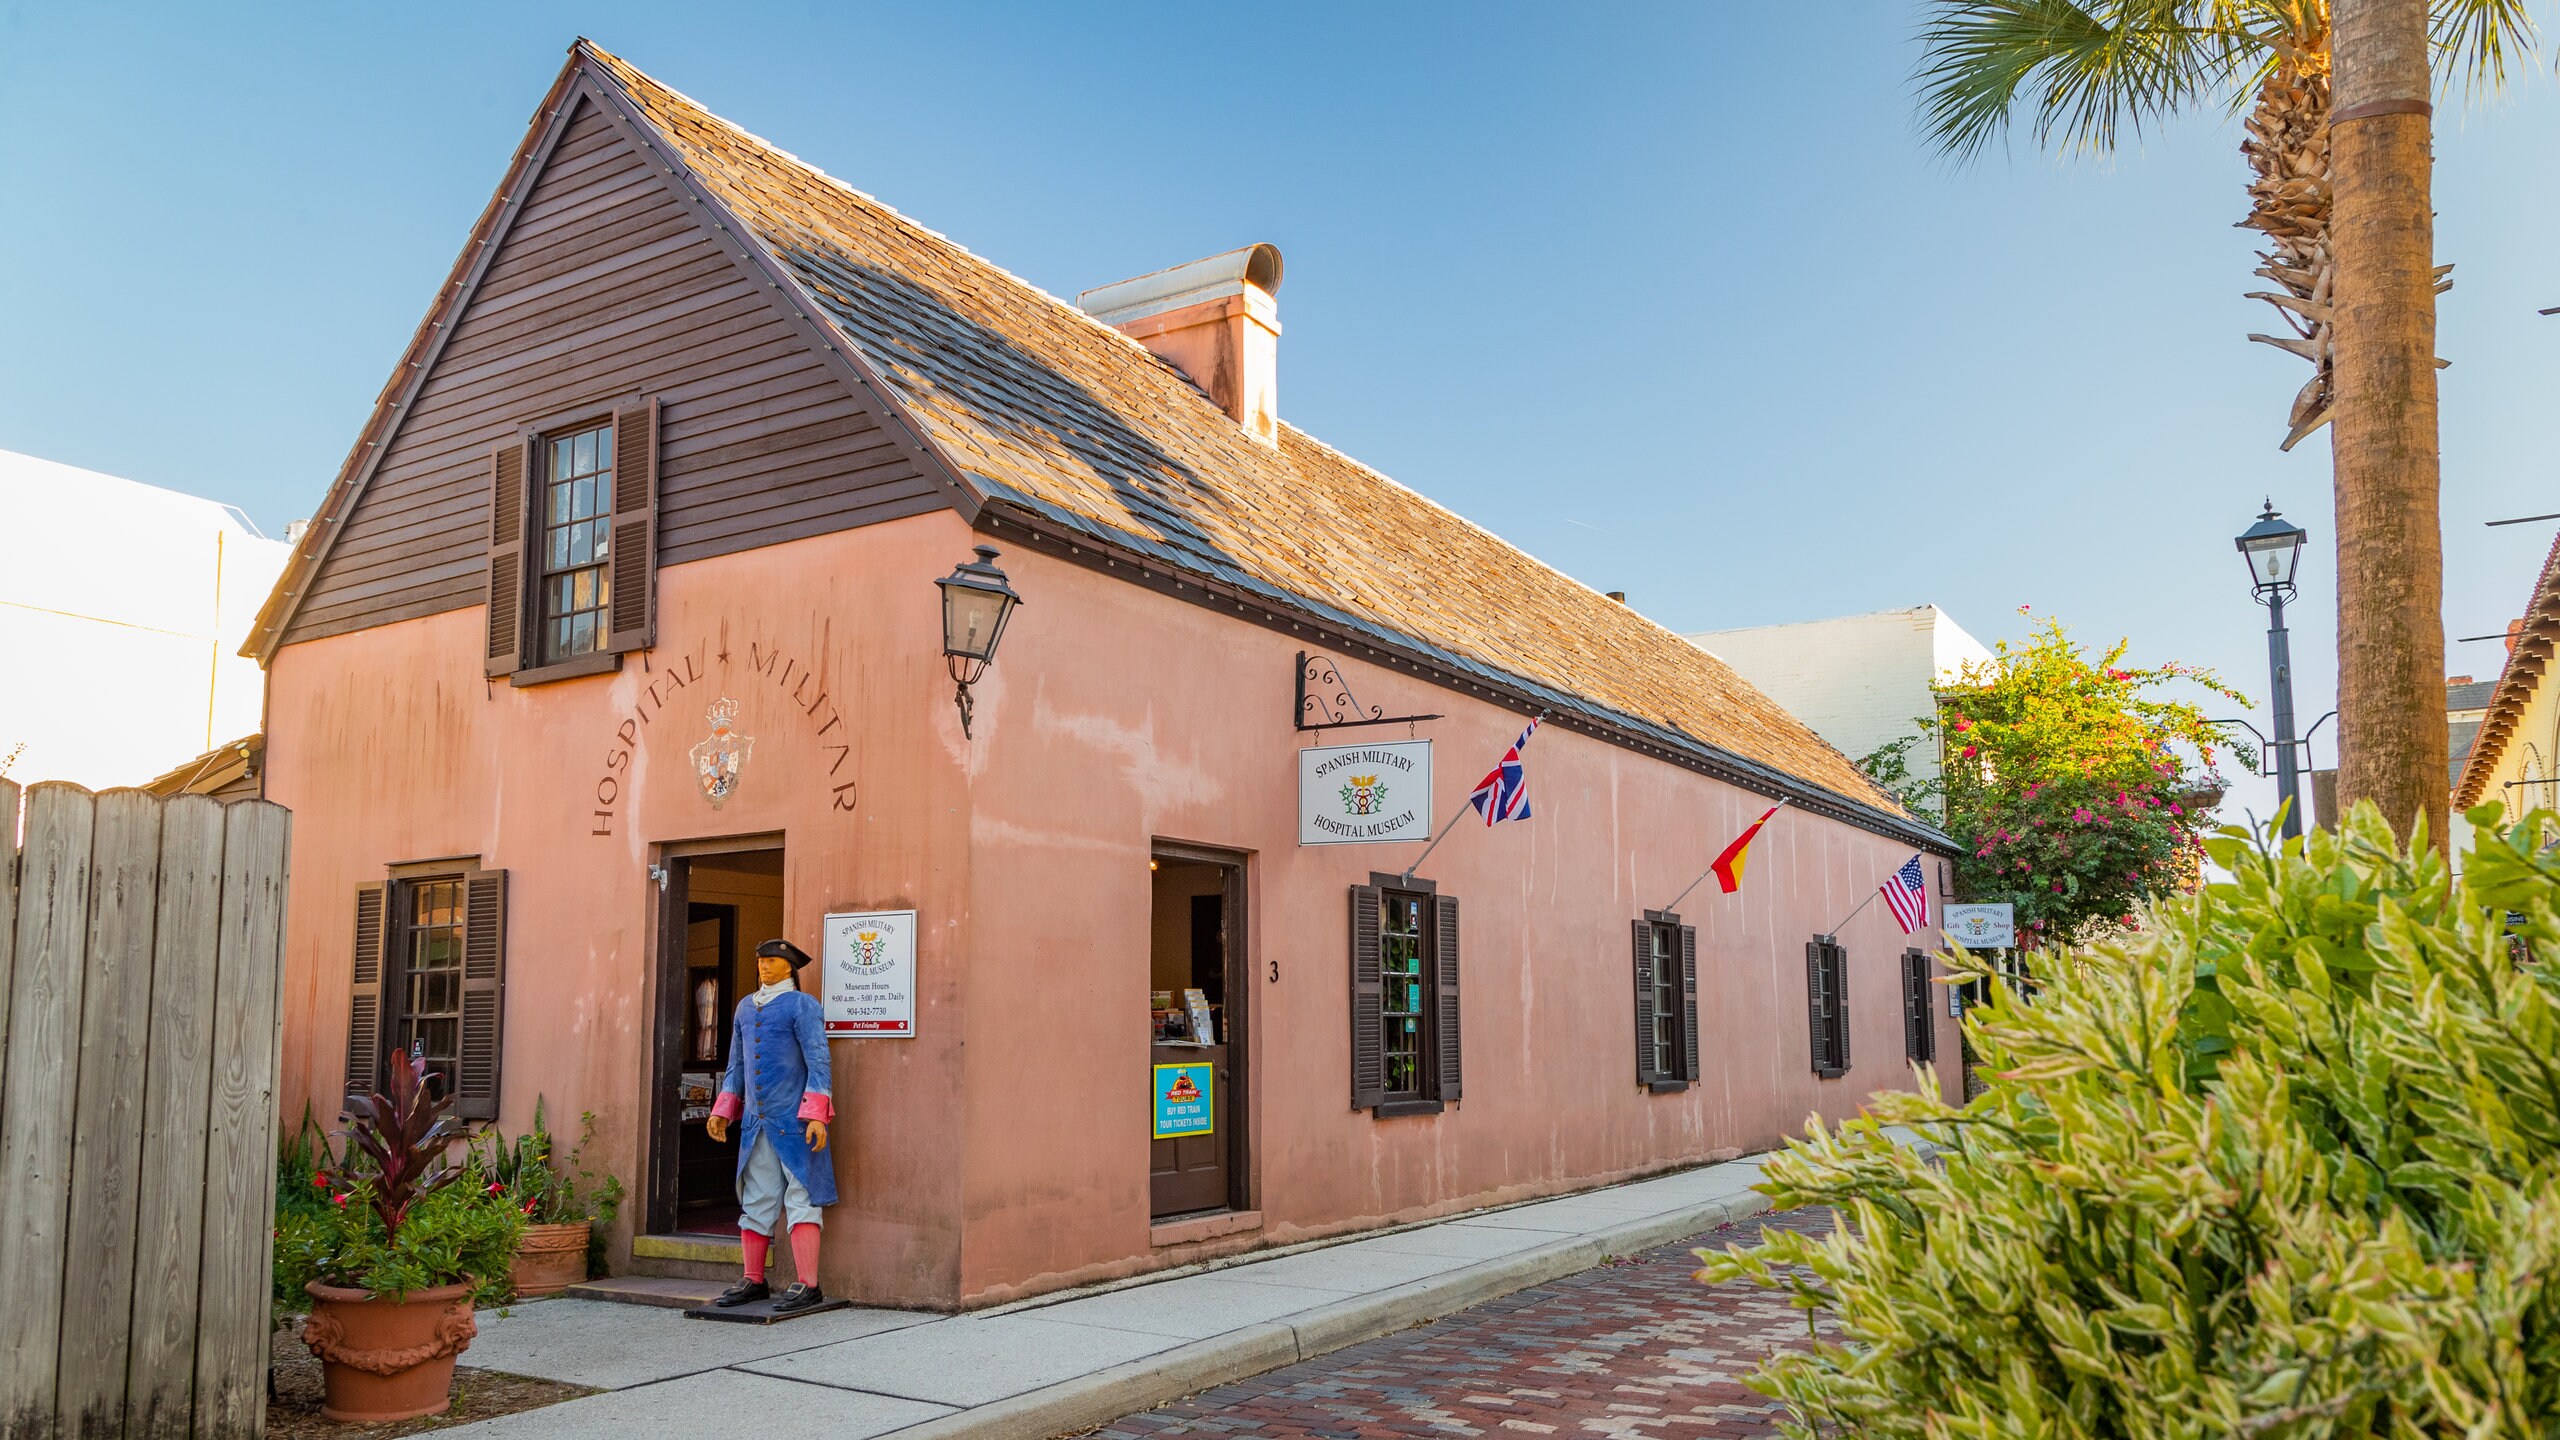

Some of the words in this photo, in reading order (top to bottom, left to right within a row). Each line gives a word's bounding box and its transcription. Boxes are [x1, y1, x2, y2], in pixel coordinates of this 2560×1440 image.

[592, 654, 704, 837] HOSPITAL
[748, 642, 857, 812] MILITAR
[1315, 751, 1360, 778] SPANISH
[1362, 750, 1415, 773] MILITARY
[1313, 814, 1365, 837] HOSPITAL
[1367, 810, 1415, 837] MUSEUM
[1952, 907, 1976, 918] SPANISH
[1977, 907, 2004, 918] MILITARY
[842, 920, 867, 937] SPANISH
[868, 920, 895, 934] MILITARY
[1993, 922, 2010, 930] Shop
[1953, 934, 1980, 945] HOSPITAL
[1981, 933, 2006, 944] MUSEUM
[840, 960, 868, 976] HOSPITAL
[869, 958, 896, 975] MUSEUM
[1269, 960, 1280, 983] 3
[871, 982, 890, 990] Hours
[861, 994, 872, 1002] 5:00
[874, 995, 887, 1003] p.m.
[888, 992, 904, 1002] Daily
[846, 1007, 887, 1016] 904-342-7730
[861, 1022, 880, 1030] Friendly
[1166, 1107, 1177, 1115] BUY
[1177, 1106, 1186, 1115] RED
[1187, 1105, 1201, 1114] TRAIN
[1160, 1120, 1173, 1129] TOUR
[1173, 1118, 1193, 1128] TICKETS
[1192, 1116, 1207, 1126] INSIDE
